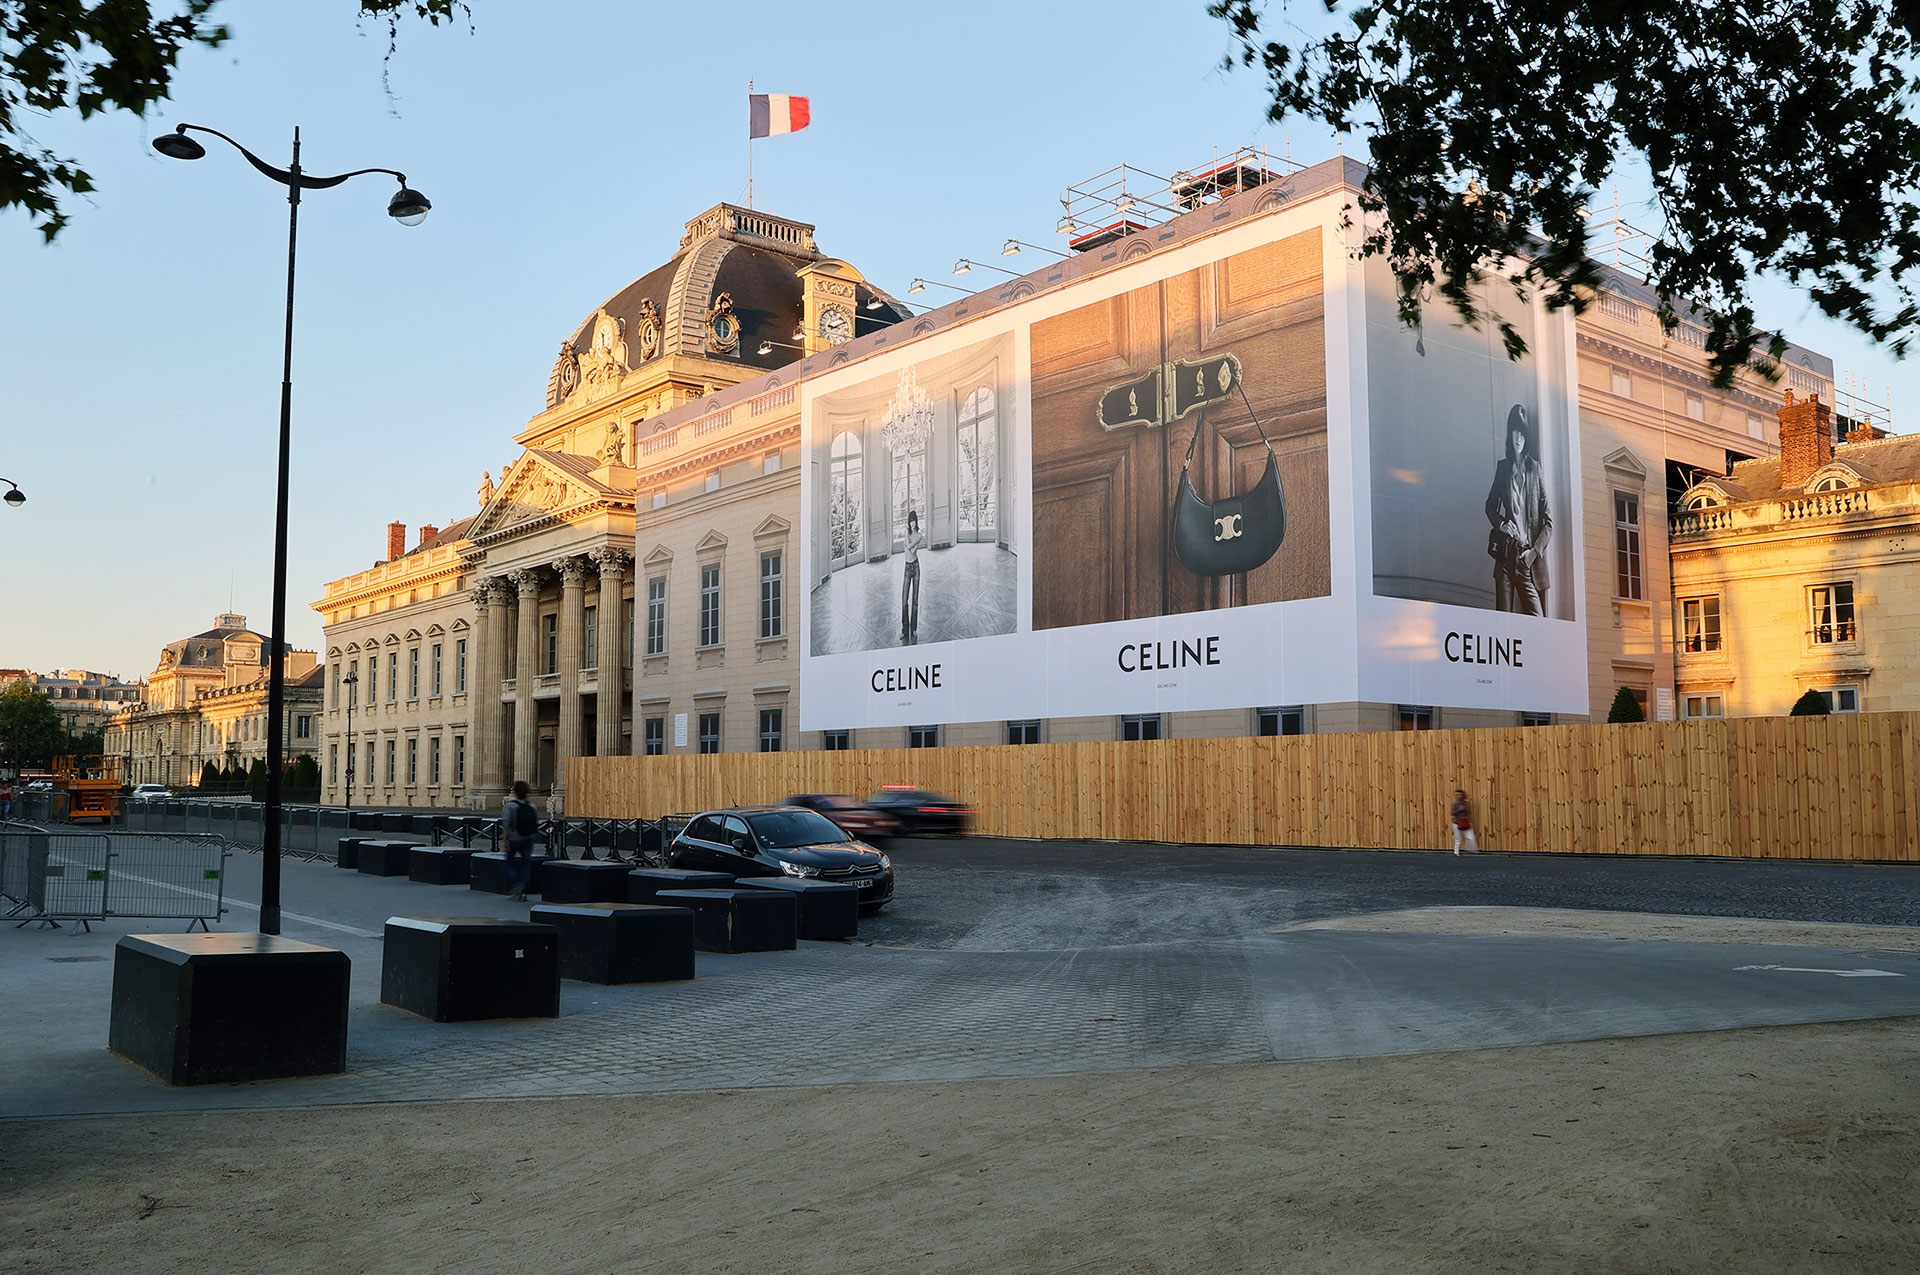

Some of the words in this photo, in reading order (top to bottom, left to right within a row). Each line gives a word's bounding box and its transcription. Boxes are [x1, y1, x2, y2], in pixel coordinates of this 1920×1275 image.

[1118, 636, 1221, 673] CELINE
[1445, 631, 1523, 668] CELINE
[871, 663, 942, 693] CELINE
